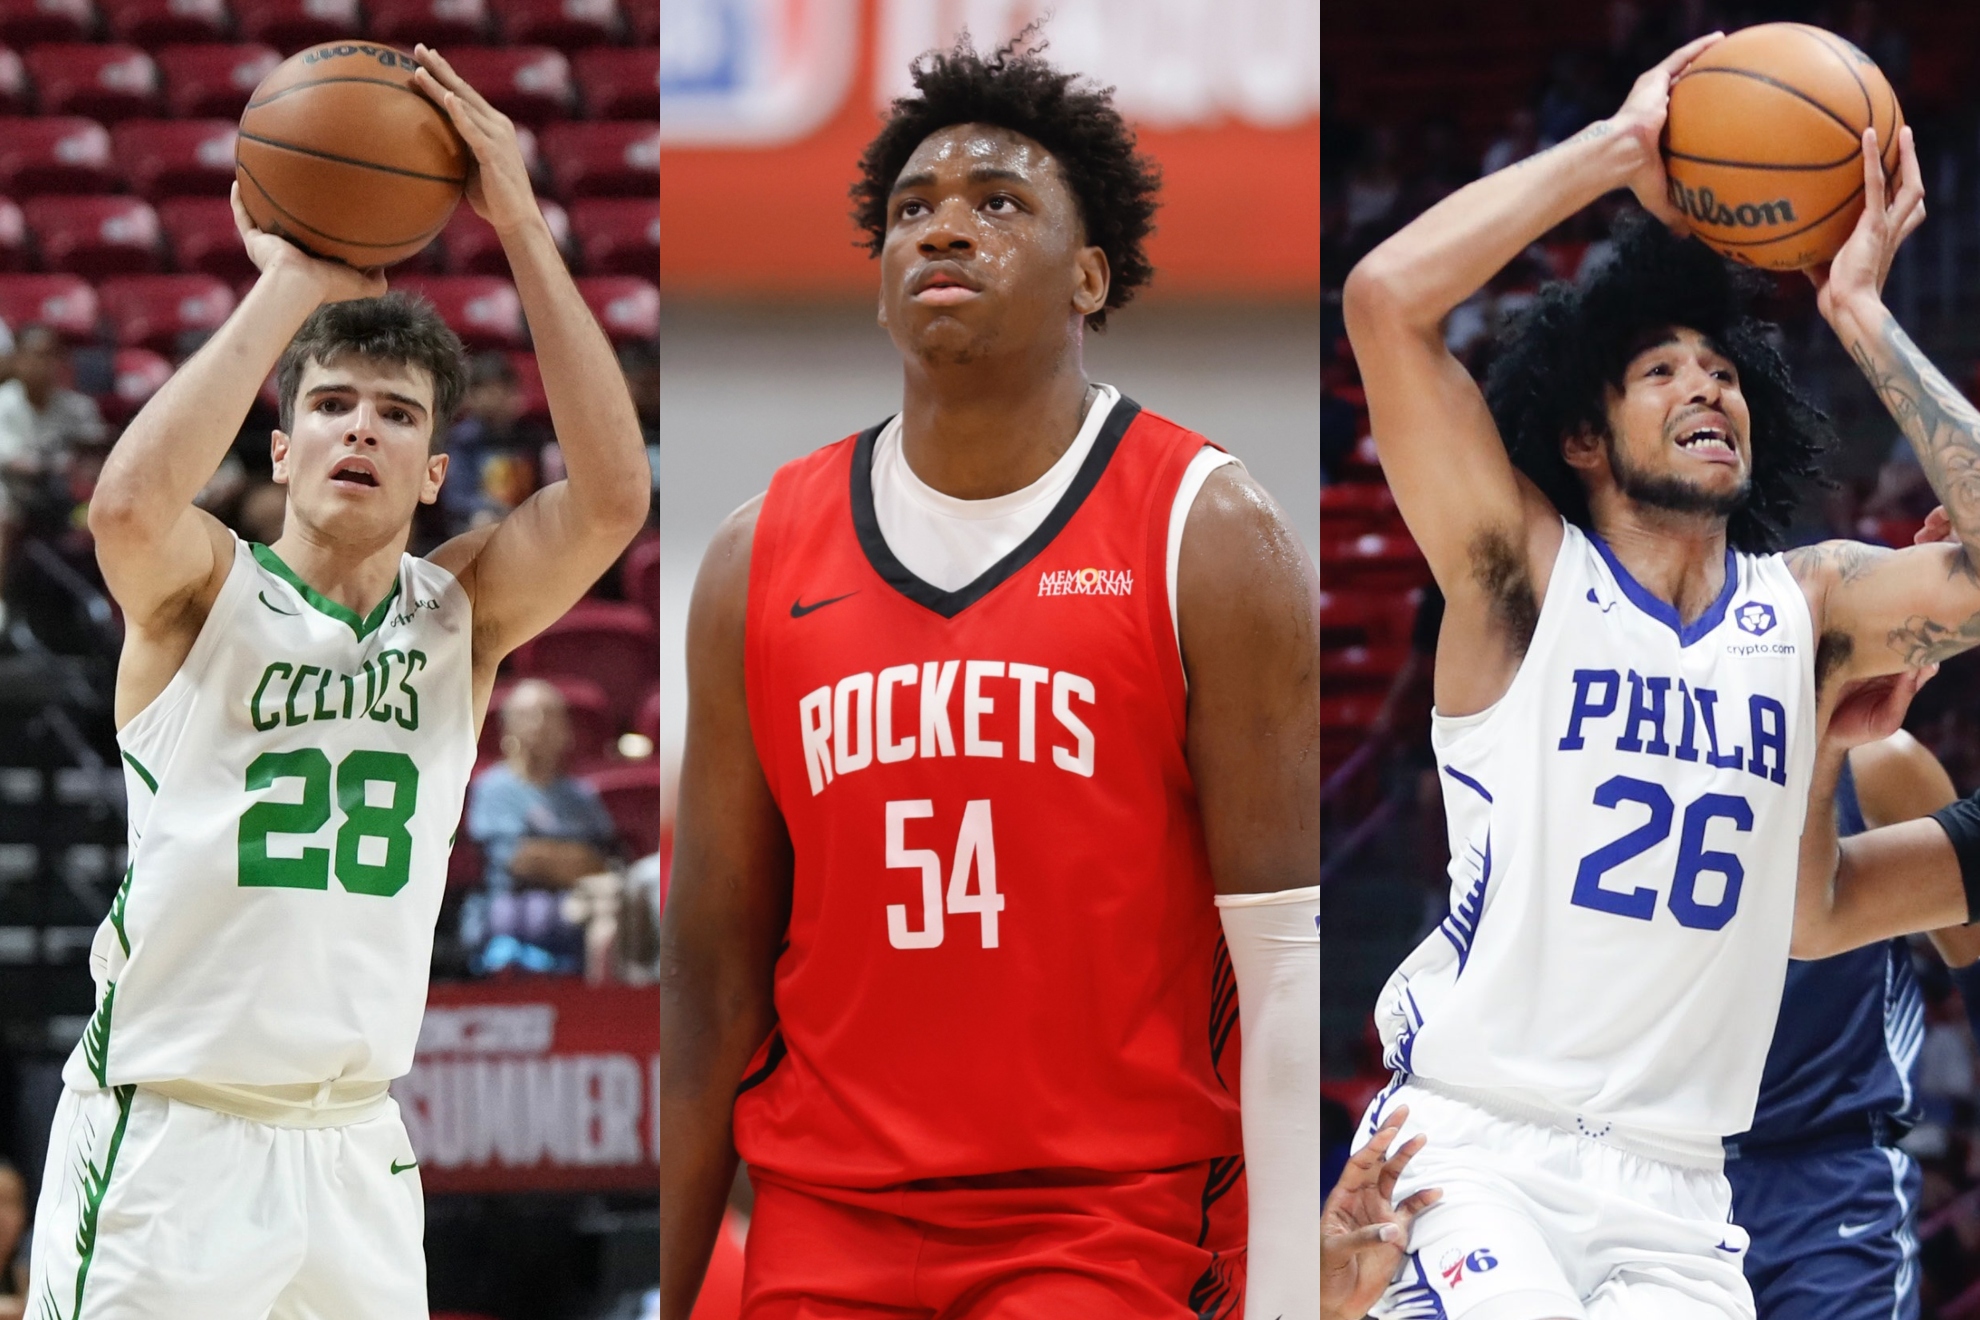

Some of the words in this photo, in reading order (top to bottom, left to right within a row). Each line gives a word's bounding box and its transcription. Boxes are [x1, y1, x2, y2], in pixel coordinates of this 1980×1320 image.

[303, 45, 420, 73] ilson
[1037, 581, 1133, 597] HERMANN
[1039, 567, 1134, 586] MEMORIAL
[250, 648, 428, 733] CELTICS
[1726, 643, 1796, 657] crypto.com
[799, 659, 1096, 797] ROCKETS
[1557, 668, 1787, 787] PHILA
[237, 747, 420, 897] 28
[1570, 774, 1755, 932] 26
[885, 799, 1005, 950] 54
[1439, 1247, 1499, 1290] 76
